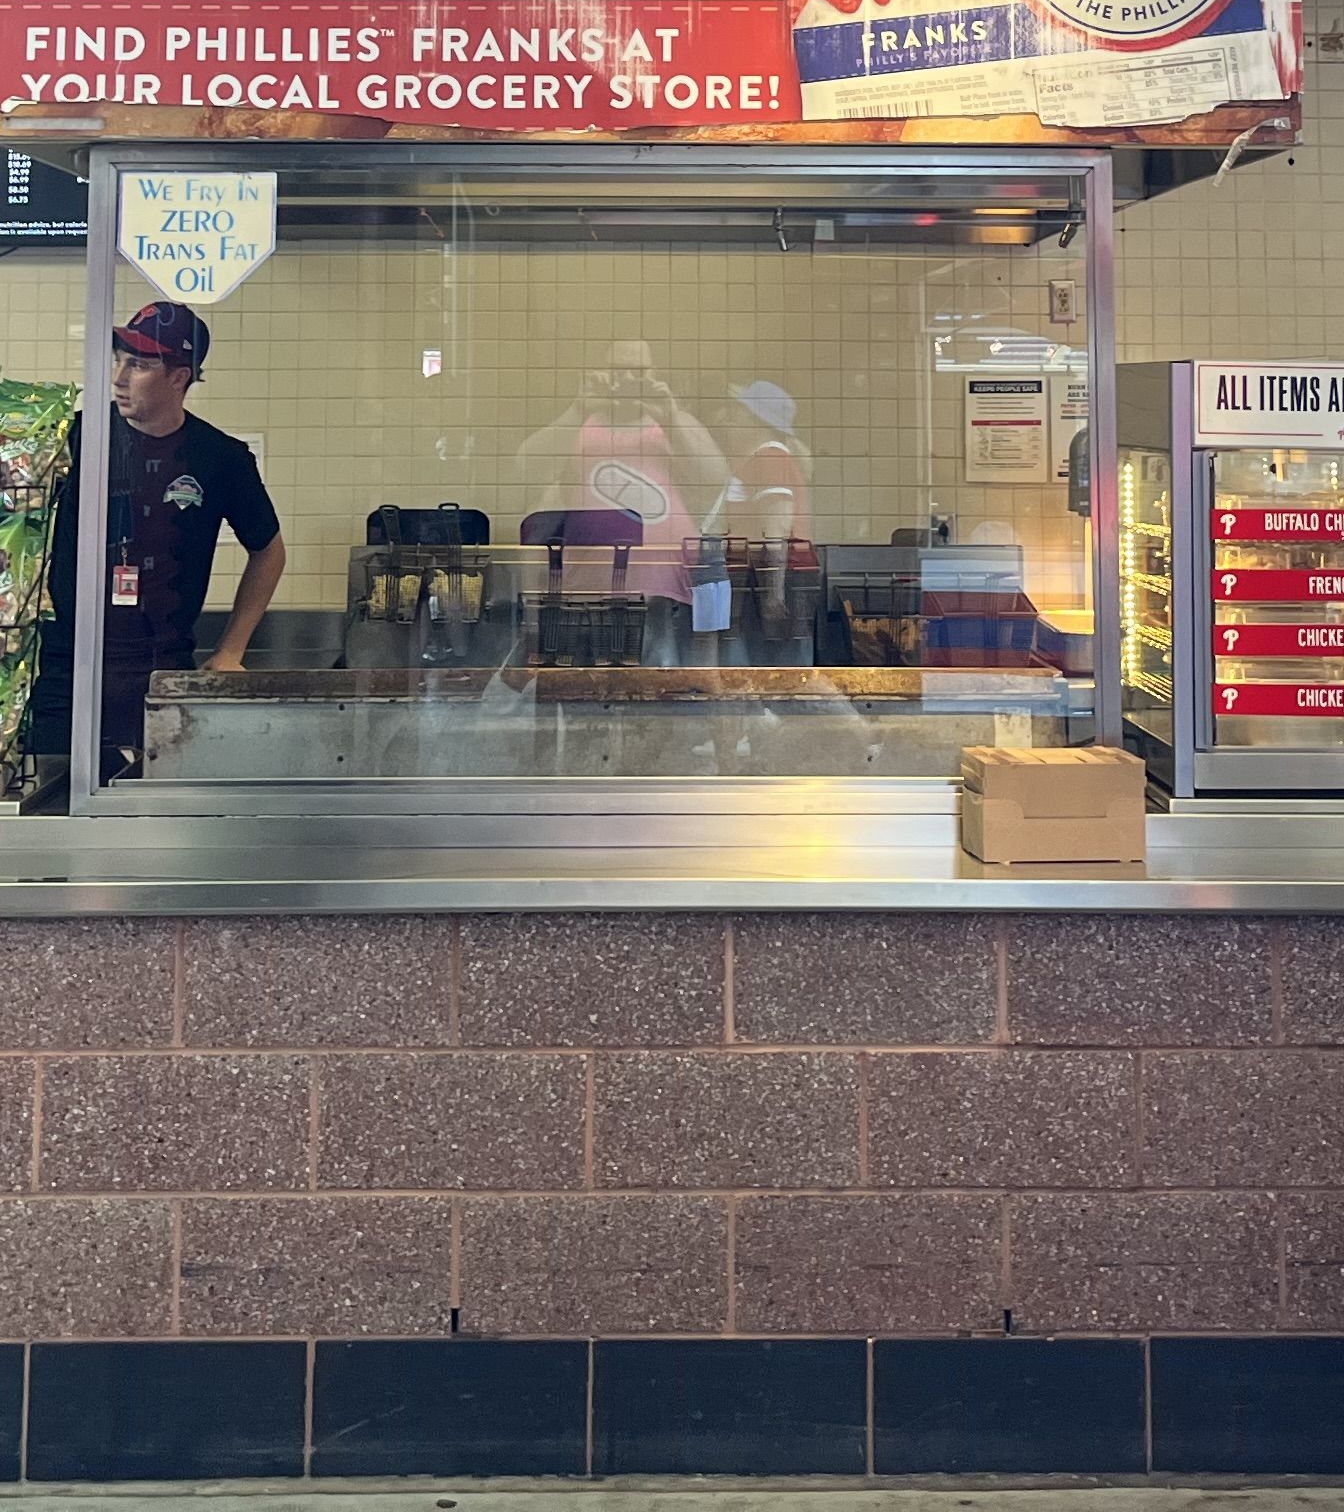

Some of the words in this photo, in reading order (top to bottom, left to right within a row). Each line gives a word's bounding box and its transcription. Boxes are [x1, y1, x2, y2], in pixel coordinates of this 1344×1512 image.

[26, 26, 146, 61] FIND
[413, 28, 604, 62] FRANKS
[622, 29, 680, 62] AT
[861, 20, 987, 54] FRANKS
[21, 73, 162, 105] YOUR
[182, 74, 340, 109] LOCAL
[358, 74, 594, 109] GROCERY
[609, 74, 780, 110] STORE!
[160, 210, 234, 233] ZERO
[175, 266, 215, 292] Oil
[1217, 375, 1252, 411] ALL
[1259, 376, 1320, 412] ITEMS
[1264, 514, 1319, 532] BUFFALO
